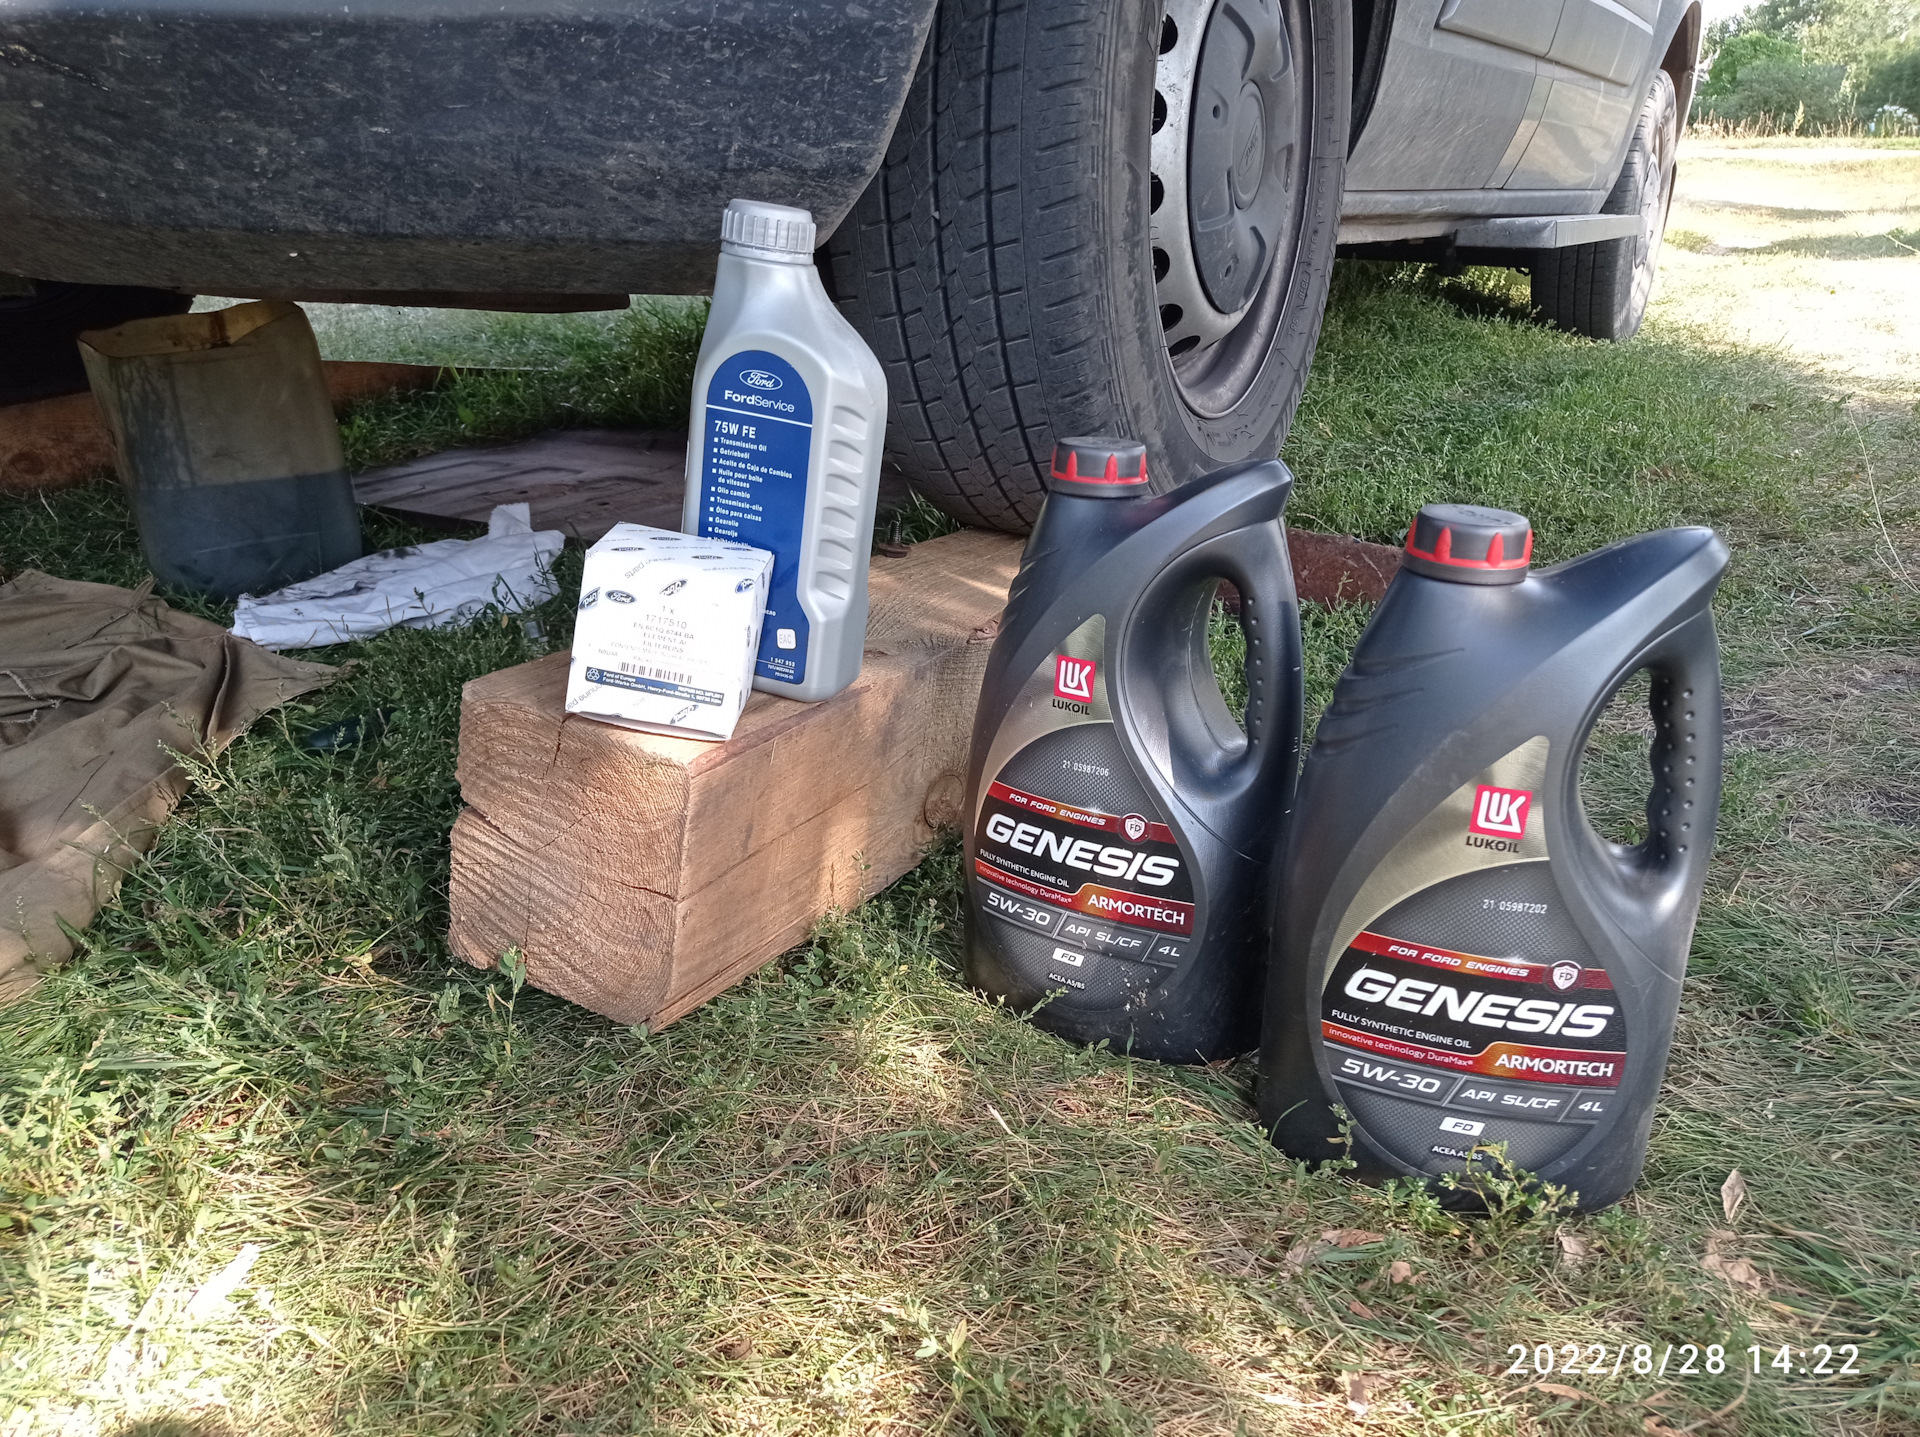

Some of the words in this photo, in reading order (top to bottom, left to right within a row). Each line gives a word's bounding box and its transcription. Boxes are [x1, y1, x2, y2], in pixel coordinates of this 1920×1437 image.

[724, 390, 795, 413] FordService
[714, 420, 739, 435] 75W
[742, 425, 757, 439] FE
[720, 437, 757, 450] Transmission
[758, 444, 767, 452] Oil
[718, 458, 737, 468] Aceite
[738, 461, 746, 469] de
[746, 463, 760, 472] Caja
[768, 467, 793, 479] Cambios
[718, 468, 733, 477] Huile
[734, 472, 747, 480] pour
[717, 486, 729, 495] Olio
[730, 489, 751, 499] cambio
[726, 478, 750, 488] vitesses
[729, 510, 743, 518] para
[743, 512, 762, 522] caixas
[646, 614, 688, 630] 1717510
[779, 634, 792, 644] EAC
[603, 671, 614, 679] Ford
[1058, 660, 1092, 698] LUK
[1052, 698, 1090, 715] LUKOIL
[1062, 760, 1071, 769] 21
[1073, 762, 1110, 777] 05987206
[1008, 793, 1028, 805] FOR
[1029, 801, 1057, 814] FORD
[1059, 809, 1107, 826] ENGINES
[1476, 790, 1527, 834] LUK
[986, 813, 1180, 887] GENESIS
[1465, 835, 1520, 854] LUKOIL
[980, 848, 996, 862] FULLY
[996, 854, 1030, 876] SYNTHETIC
[1030, 869, 1057, 884] ENGINE
[1056, 877, 1070, 888] OIL
[979, 865, 1005, 882] innovative
[1005, 876, 1039, 896] technology
[1087, 893, 1185, 925] ARMORTECH
[1482, 899, 1495, 909] 21
[1499, 901, 1548, 914] 05987202
[987, 891, 1051, 926] 5W-30
[1064, 924, 1091, 937] API
[1094, 931, 1142, 948] SL/CF
[1158, 945, 1181, 958] 4L
[1060, 952, 1077, 963] FD
[1387, 944, 1418, 958] FOR
[1421, 953, 1462, 966] FORD
[1465, 961, 1530, 977] ENGINES
[1048, 972, 1067, 984] ACEA
[1066, 978, 1085, 990] A5/B5
[1344, 968, 1615, 1038] GENESIS
[1331, 1009, 1360, 1024] FULLY
[1360, 1017, 1415, 1038] SYNTHETIC
[1415, 1031, 1453, 1046] ENGINE
[1454, 1038, 1472, 1049] OIL
[1328, 1027, 1374, 1047] innovative
[1374, 1039, 1426, 1060] technology
[1494, 1053, 1615, 1077] ARMORTECH
[1340, 1058, 1442, 1093] 5W-30
[1460, 1088, 1497, 1102] API
[1500, 1094, 1561, 1110] SL/CF
[1578, 1101, 1604, 1112] 4L
[1452, 1121, 1474, 1132] FD
[1431, 1145, 1457, 1157] ACEA
[1456, 1150, 1483, 1161] A5B5
